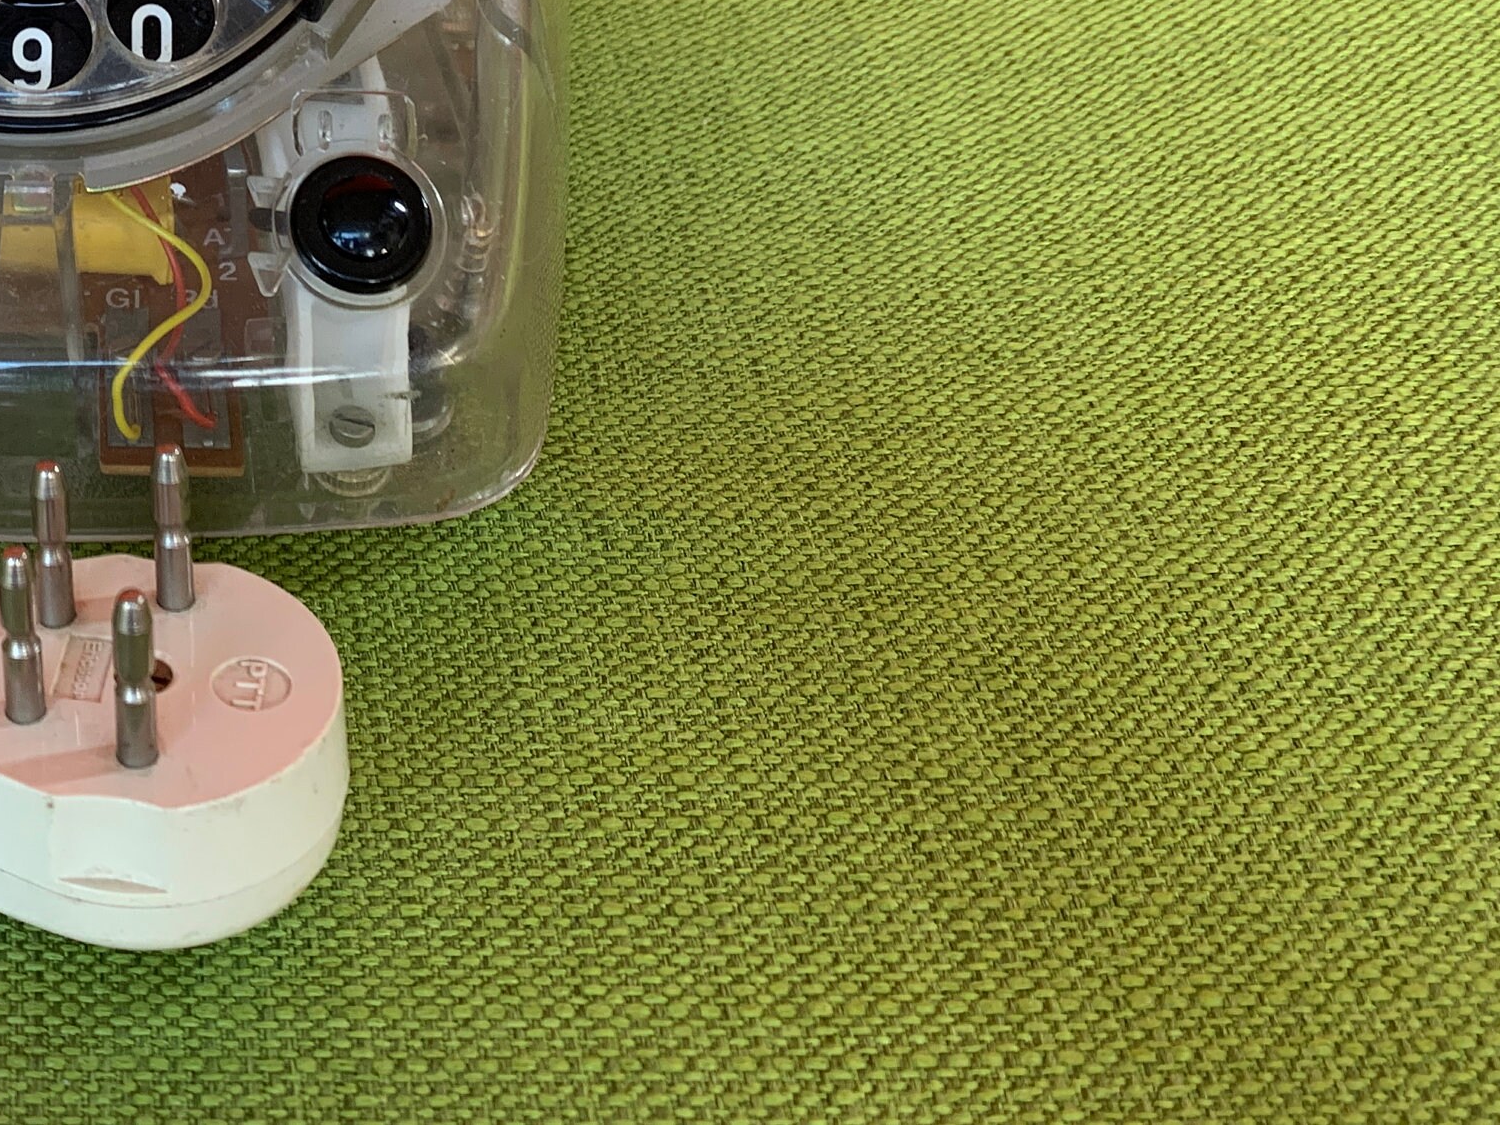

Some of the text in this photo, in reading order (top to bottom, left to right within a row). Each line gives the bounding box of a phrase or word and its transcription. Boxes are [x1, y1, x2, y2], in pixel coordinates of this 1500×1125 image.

[11, 26, 53, 91] 9
[131, 3, 173, 63] 0
[231, 660, 269, 711] PTT
